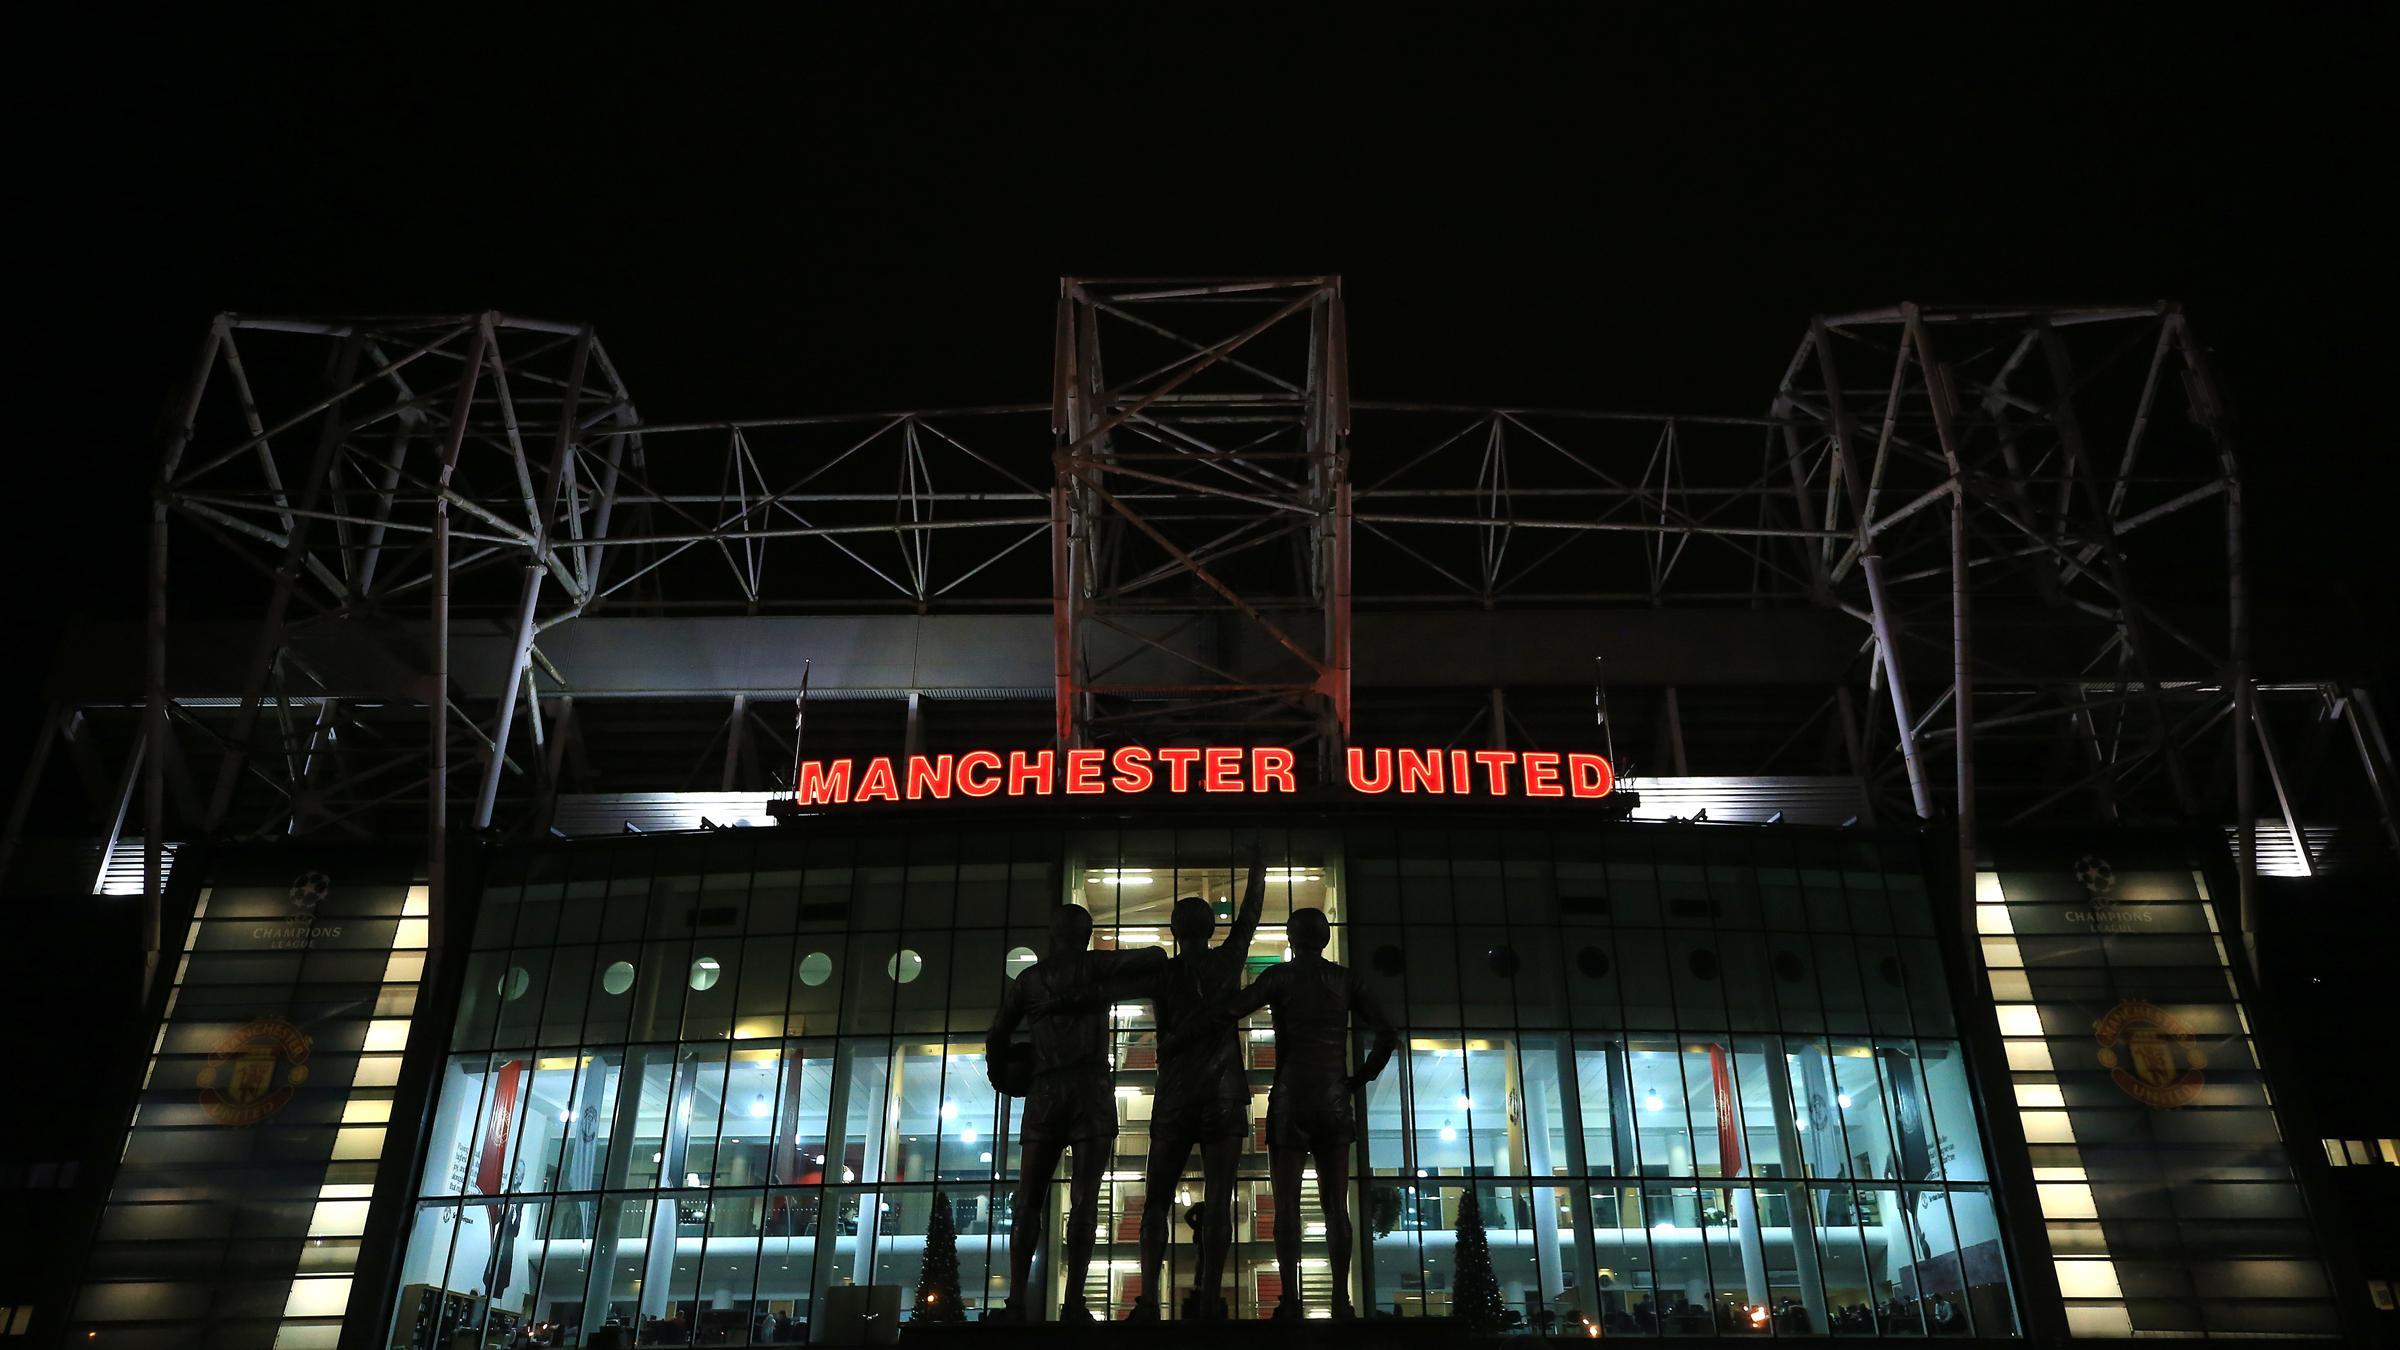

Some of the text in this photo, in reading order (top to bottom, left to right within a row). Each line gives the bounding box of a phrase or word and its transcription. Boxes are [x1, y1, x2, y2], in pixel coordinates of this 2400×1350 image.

[797, 745, 1615, 806] MANCHESTER UNITED
[2064, 911, 2153, 923] CHAMPIONS
[252, 927, 342, 939] CHAMPIONS
